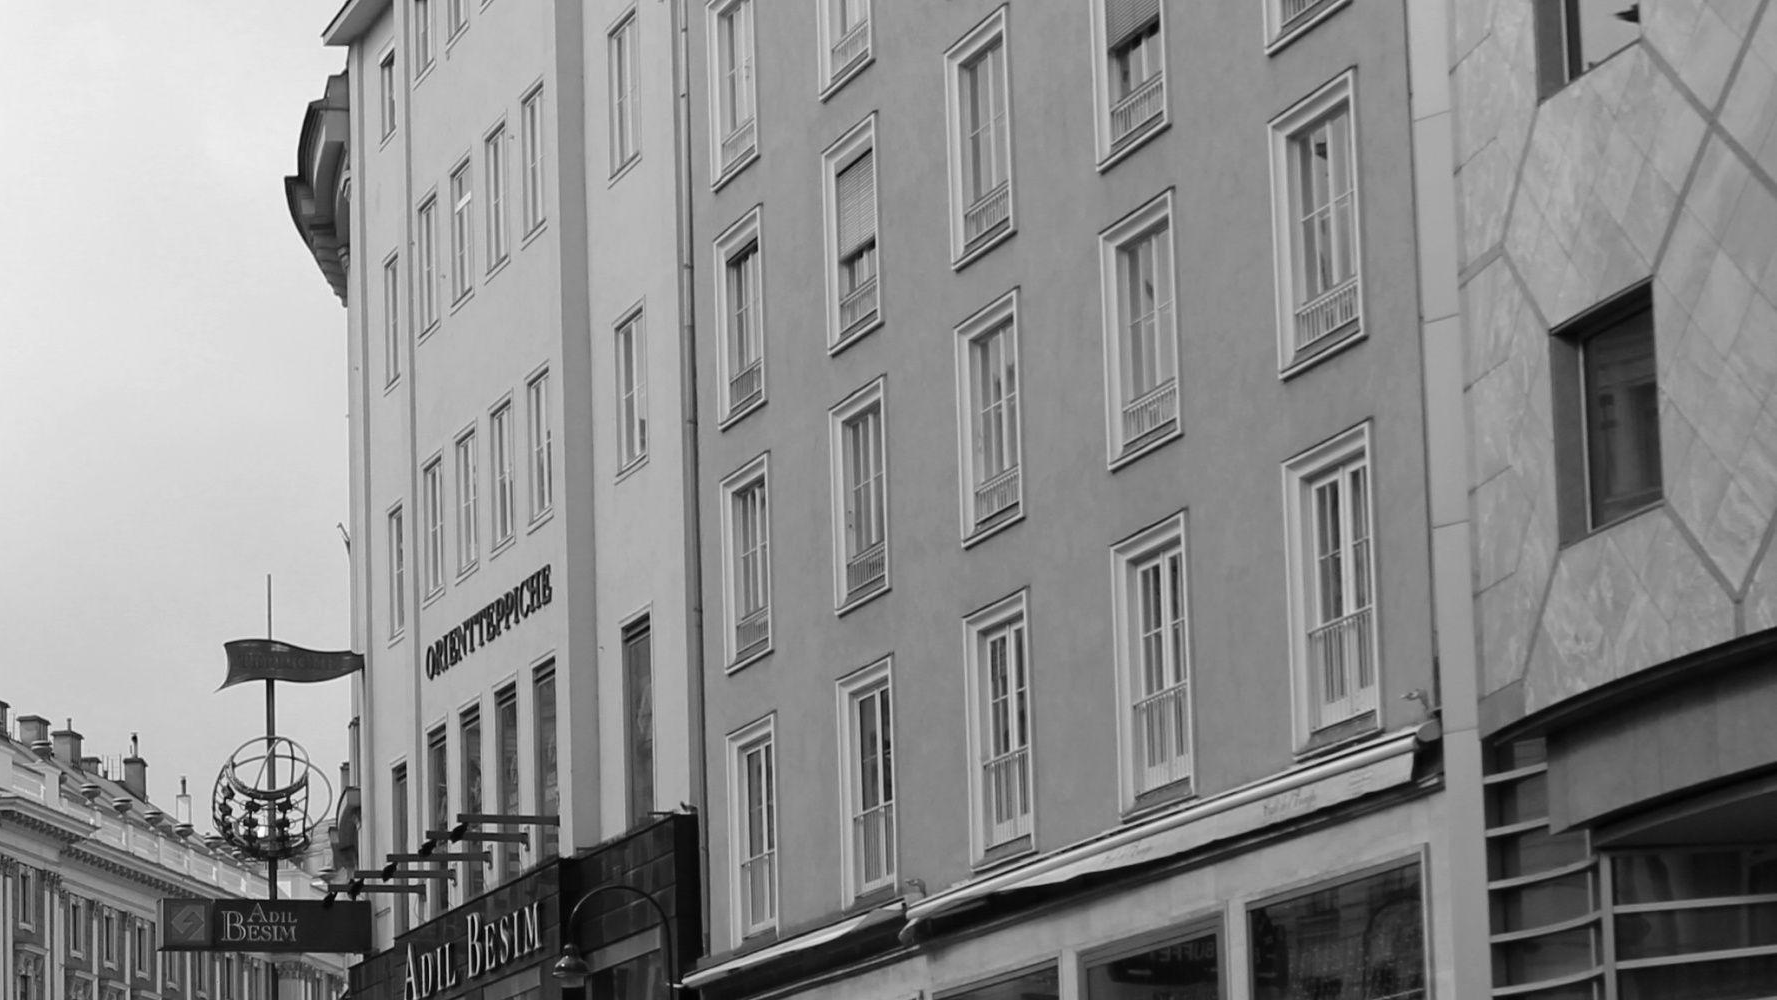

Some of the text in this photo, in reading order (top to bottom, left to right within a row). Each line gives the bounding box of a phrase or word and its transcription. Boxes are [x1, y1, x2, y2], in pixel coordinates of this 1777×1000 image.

[426, 564, 553, 681] ORIENTTEPPICHE
[221, 910, 297, 942] BESIM
[247, 902, 298, 923] ADIL
[466, 901, 543, 979] BESIM
